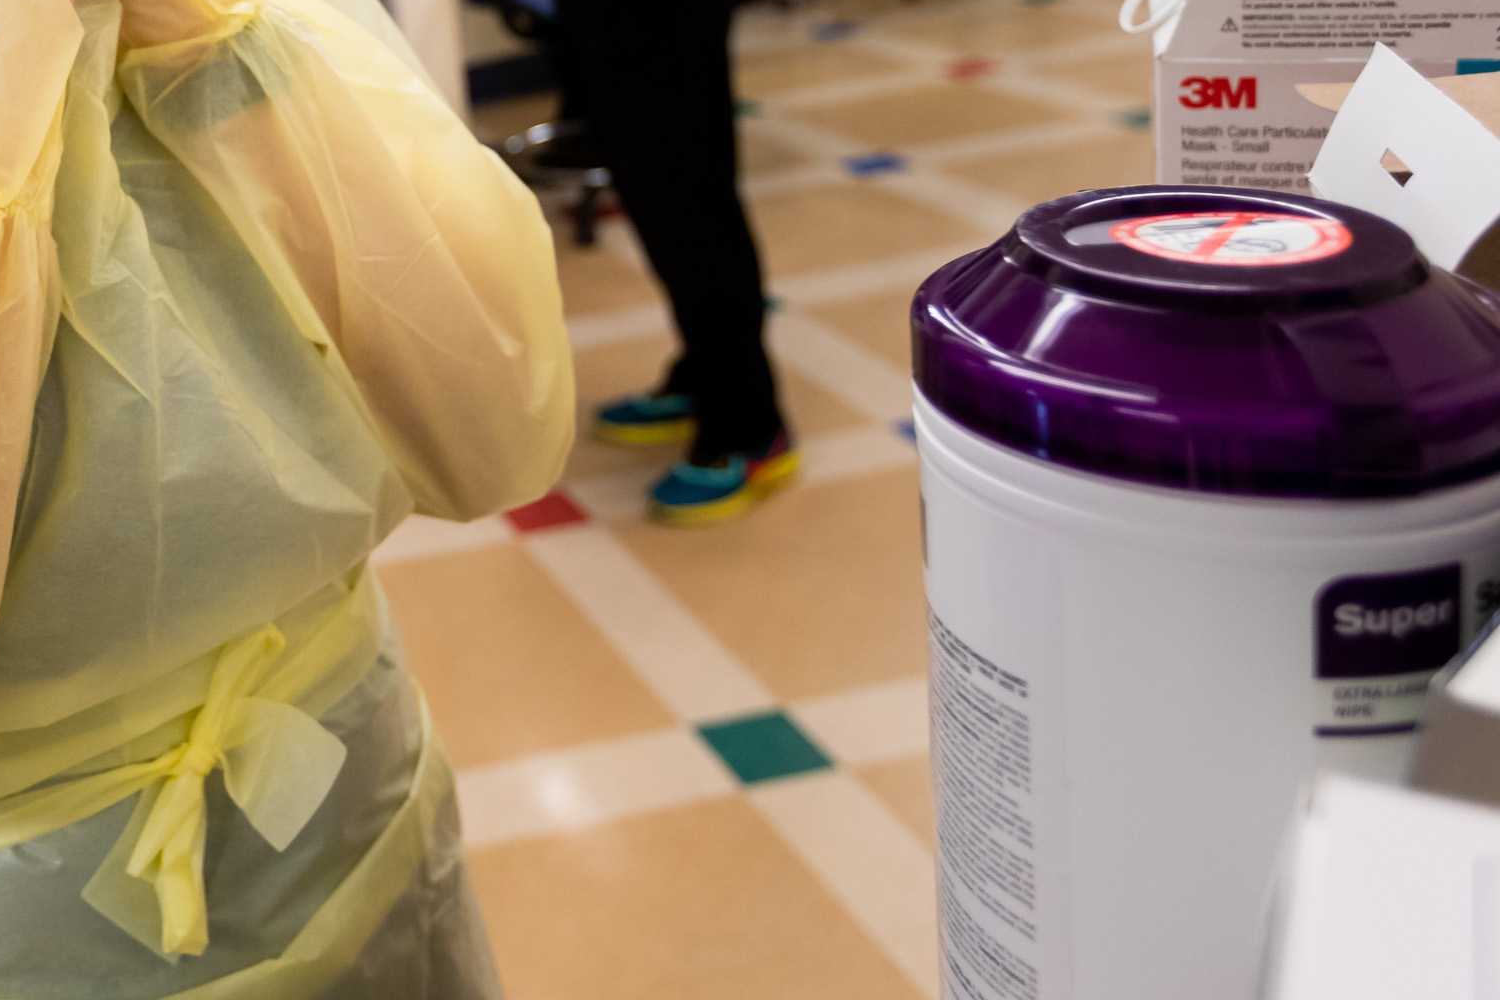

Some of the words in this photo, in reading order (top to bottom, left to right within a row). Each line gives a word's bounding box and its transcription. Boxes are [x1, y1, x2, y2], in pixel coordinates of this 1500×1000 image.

[1178, 75, 1258, 110] 3M
[1180, 125, 1223, 138] Health
[1227, 126, 1259, 138] Care
[1262, 126, 1329, 139] Particulat
[1181, 140, 1217, 152] Mask
[1231, 140, 1270, 153] Small
[1181, 158, 1257, 172] Respirateur
[1261, 161, 1305, 173] contre
[1333, 598, 1453, 640] Super
